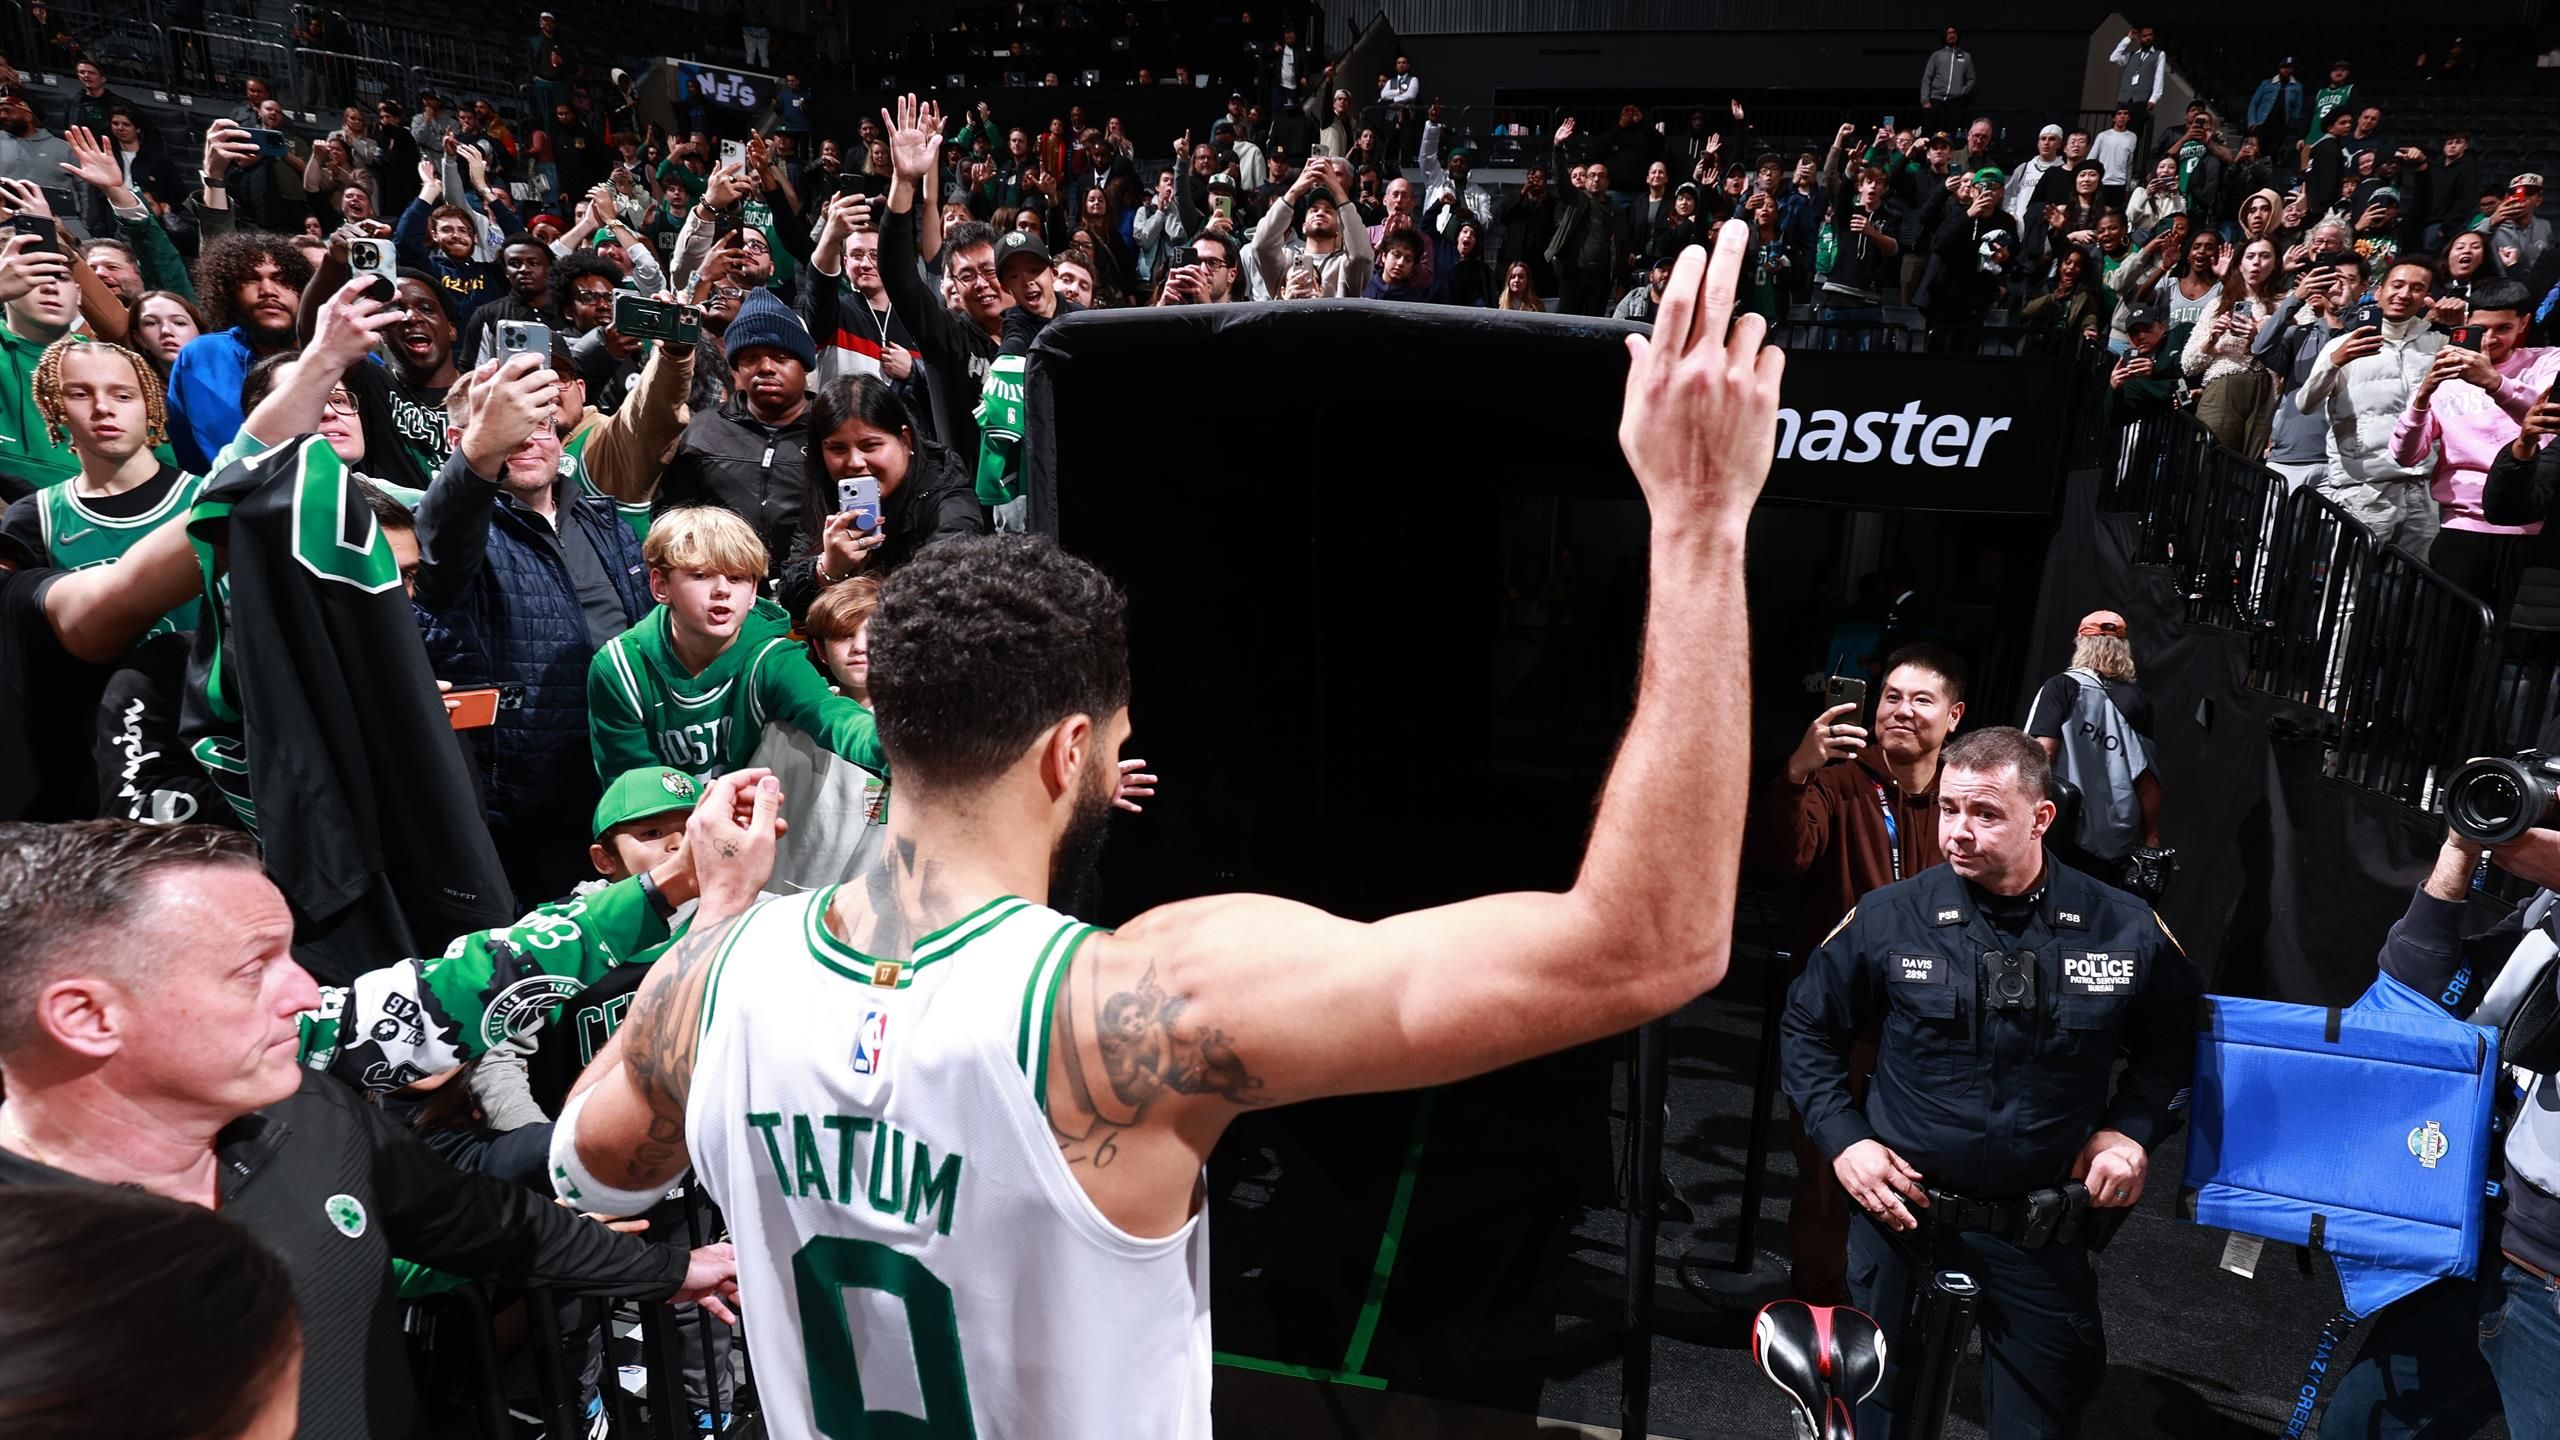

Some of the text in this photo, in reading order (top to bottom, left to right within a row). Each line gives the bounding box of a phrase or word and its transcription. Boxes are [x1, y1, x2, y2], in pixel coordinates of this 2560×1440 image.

[696, 72, 756, 106] NETS
[1938, 910, 1959, 921] PSB
[2059, 912, 2081, 923] PSB
[2086, 953, 2109, 961] NYPD
[1901, 958, 1933, 969] DAVIS
[2064, 959, 2134, 977] POLICE
[1904, 970, 1928, 980] 2896
[2070, 976, 2130, 985] PATROL SERVICES
[746, 1112, 963, 1236] TATUM
[792, 1234, 979, 1440] 0
